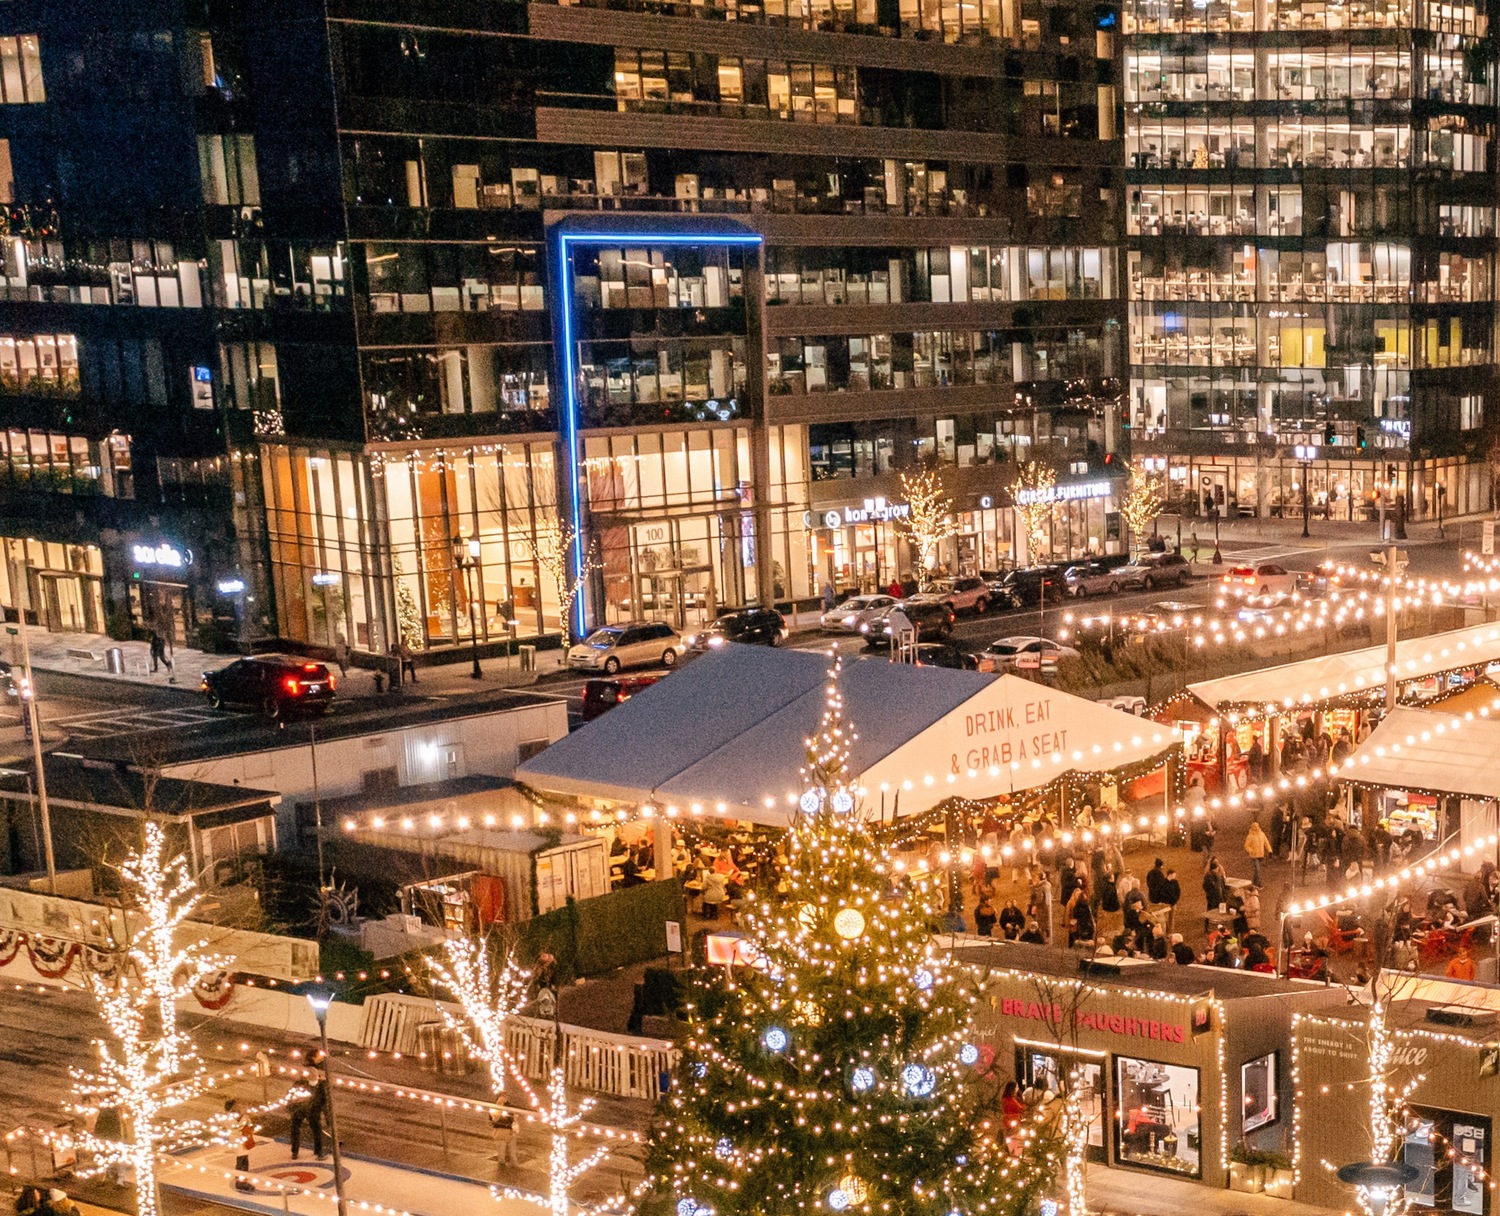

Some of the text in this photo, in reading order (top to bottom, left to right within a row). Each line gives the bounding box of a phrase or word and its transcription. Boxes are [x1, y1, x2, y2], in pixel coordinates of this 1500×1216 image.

[1057, 482, 1110, 500] FURNITURE
[845, 504, 909, 522] hongrow
[646, 529, 664, 541] 100
[966, 699, 1050, 737] DRINK, EAT
[951, 729, 1067, 774] & GRAB A SEAT
[1001, 997, 1062, 1024] BRAVE
[1303, 1036, 1316, 1044] THE
[1317, 1039, 1344, 1049] ENERGY
[1303, 1046, 1326, 1055] ABOUT
[1328, 1049, 1337, 1057] TO
